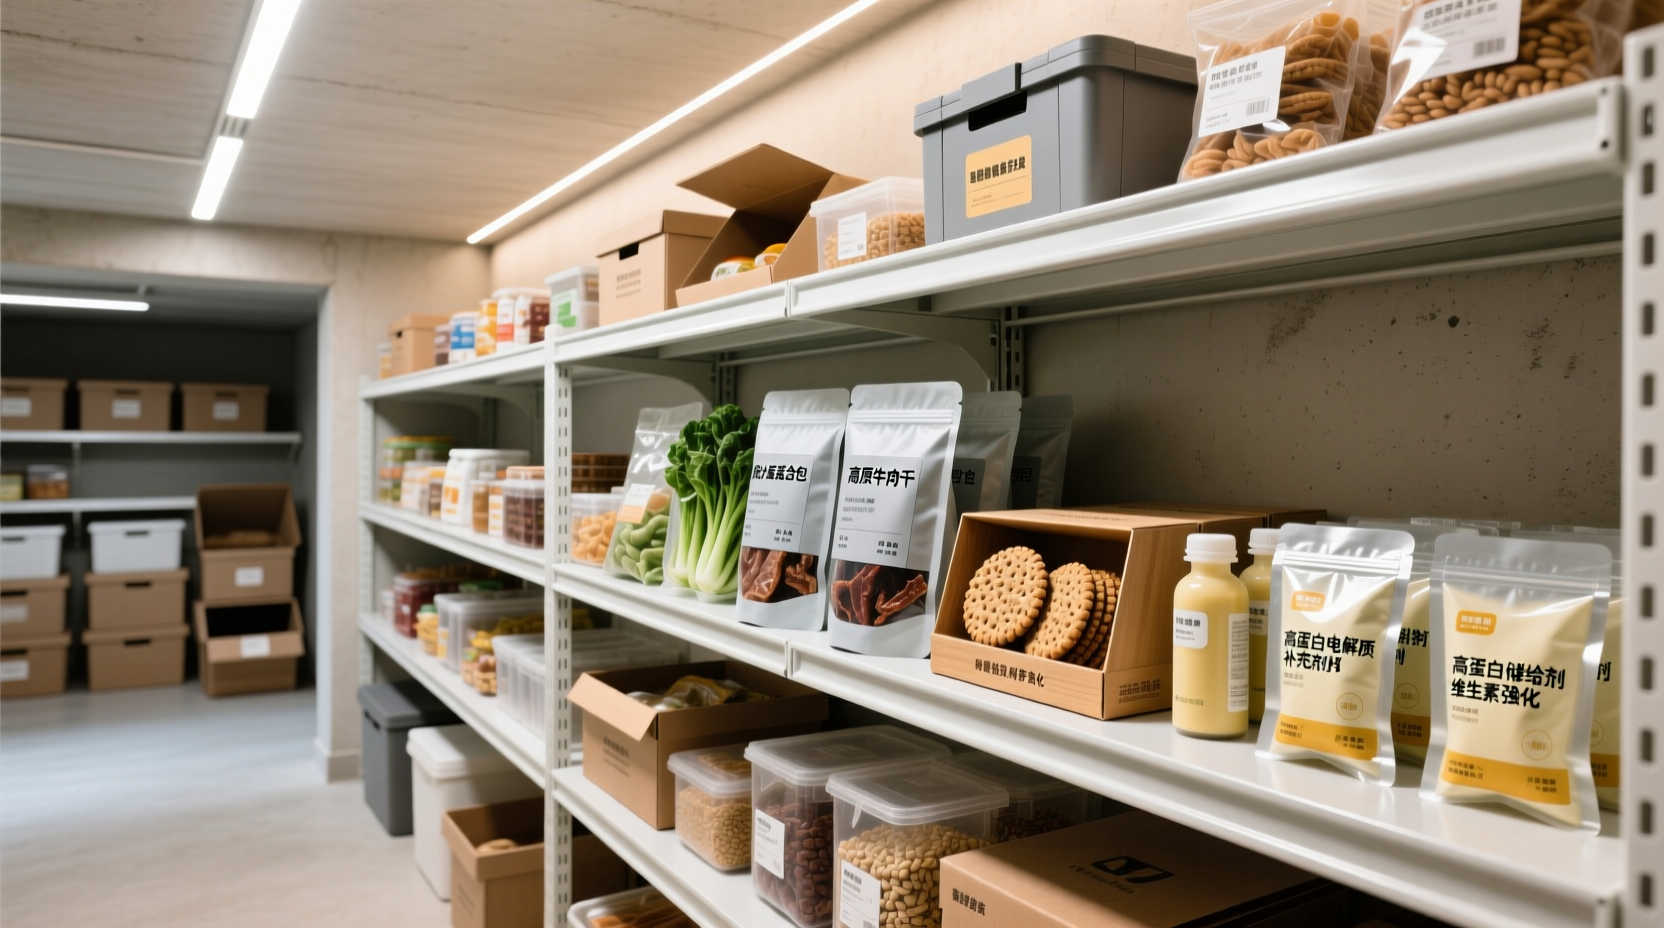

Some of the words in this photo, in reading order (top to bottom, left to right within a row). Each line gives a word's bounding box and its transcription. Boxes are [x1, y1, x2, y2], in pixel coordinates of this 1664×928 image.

[848, 466, 915, 488] 高原牛肉干
[1451, 678, 1541, 709] 维生素强化
